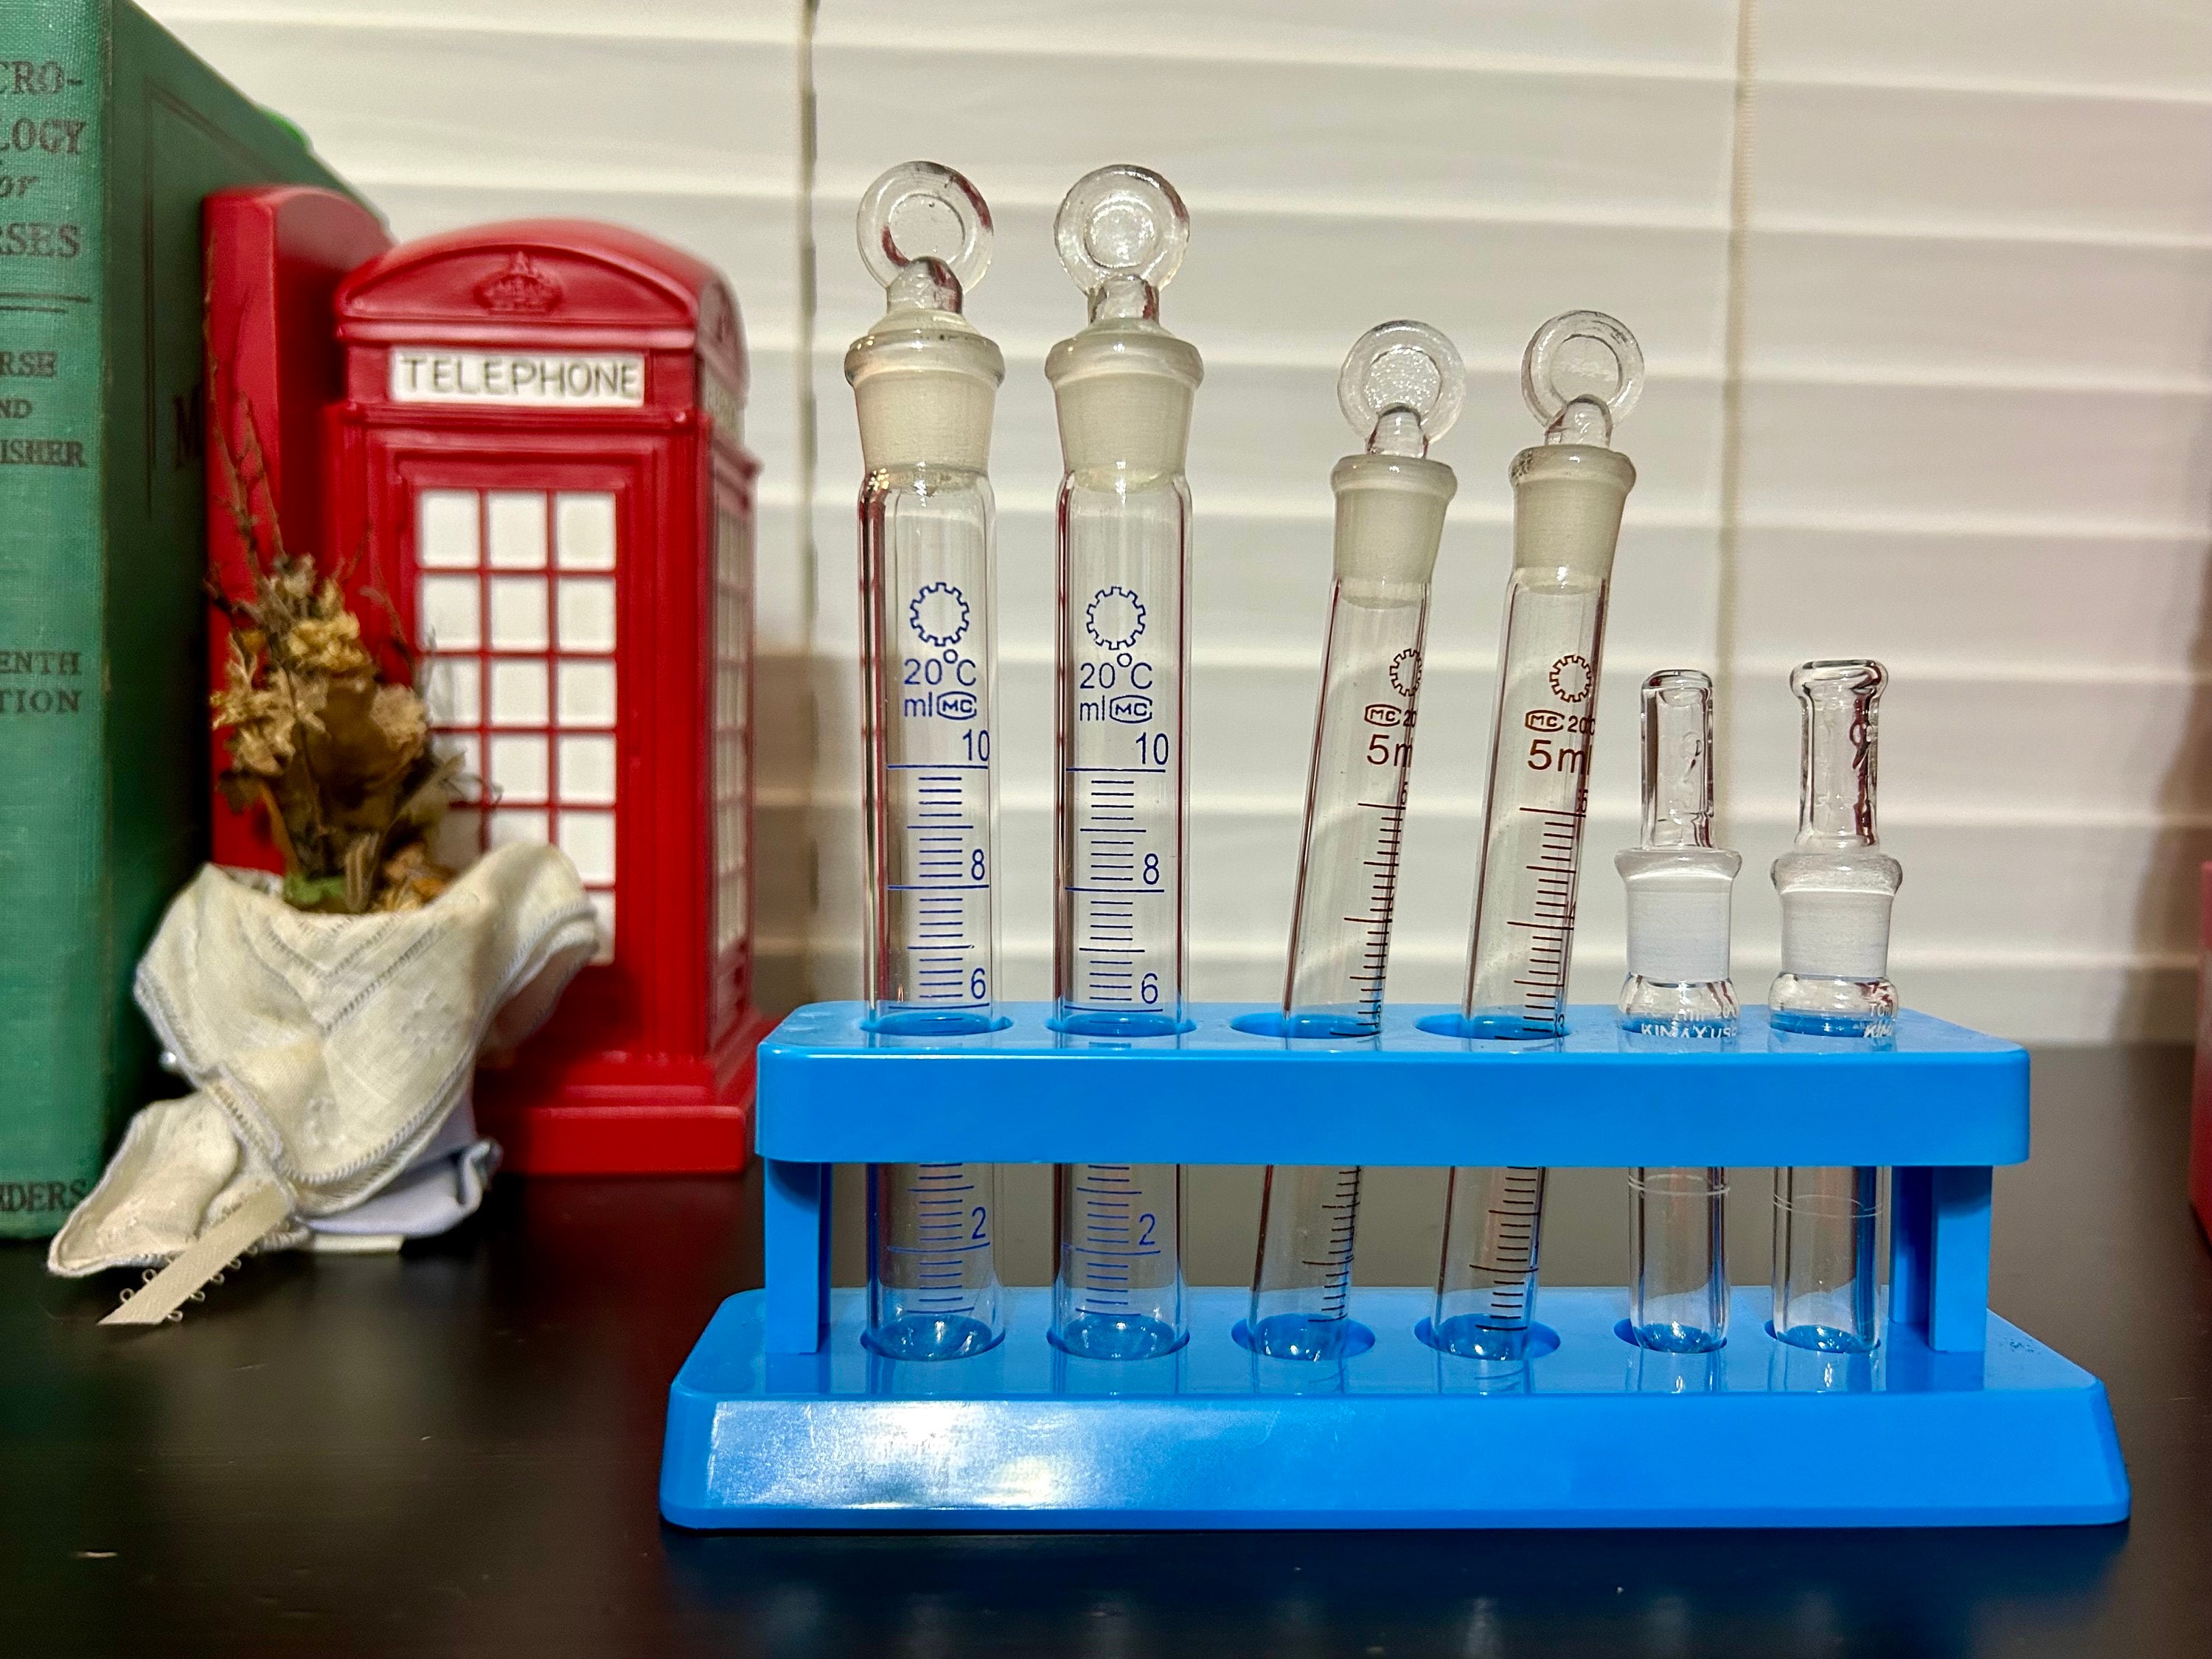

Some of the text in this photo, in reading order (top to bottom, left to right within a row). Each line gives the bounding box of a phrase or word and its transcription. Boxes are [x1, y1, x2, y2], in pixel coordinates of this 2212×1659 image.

[402, 354, 640, 399] TELEPHONE
[903, 691, 933, 717] ml
[1079, 695, 1105, 721] ml
[962, 728, 990, 762] 10
[1135, 732, 1169, 765] 10
[971, 849, 986, 880] 8
[1143, 853, 1159, 886] 8
[970, 967, 987, 1000] 6
[1141, 973, 1158, 1004] 6
[971, 1206, 987, 1239] 2
[1138, 1213, 1155, 1246] 2
